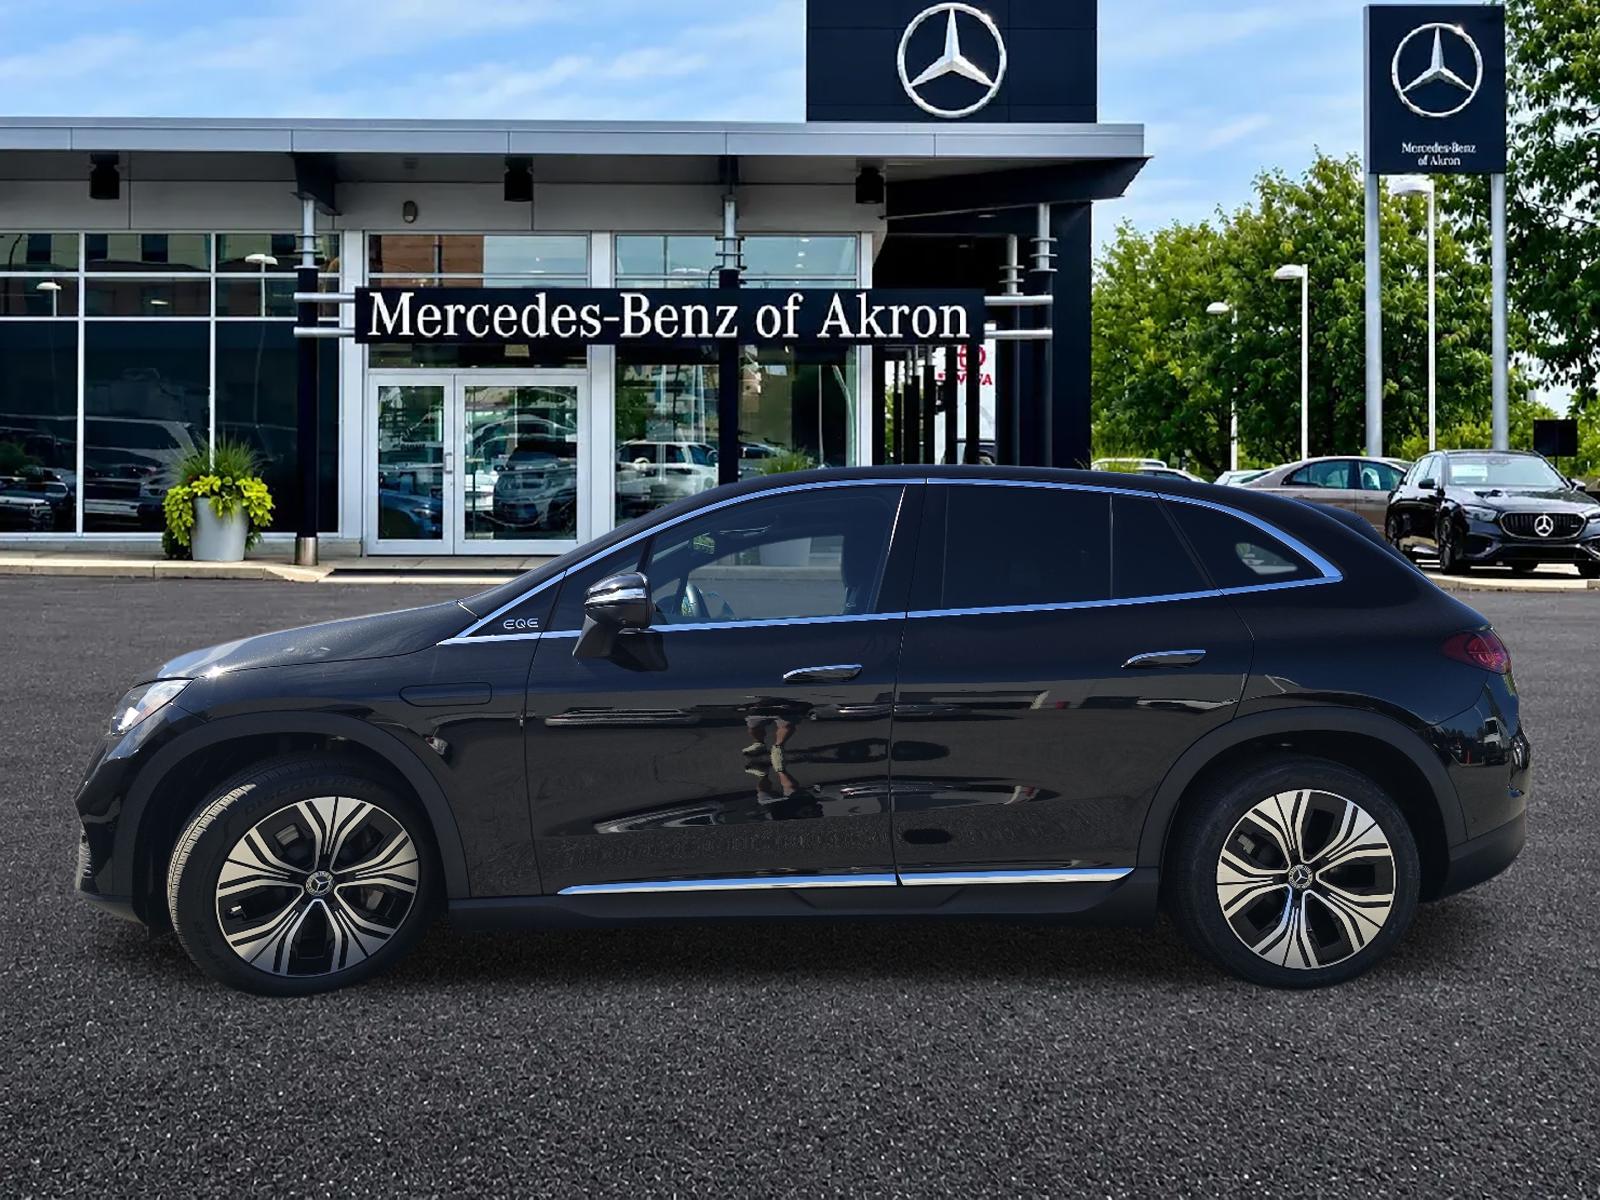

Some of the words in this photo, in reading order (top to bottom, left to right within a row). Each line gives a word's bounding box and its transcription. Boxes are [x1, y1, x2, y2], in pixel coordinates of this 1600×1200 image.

[1401, 141, 1477, 154] Mercedes-Benz
[1417, 154, 1428, 166] of
[1429, 154, 1461, 166] Akron
[367, 292, 738, 338] Mercedes-Benz
[755, 292, 804, 338] of
[816, 292, 970, 338] Akron
[502, 617, 539, 630] EQE
